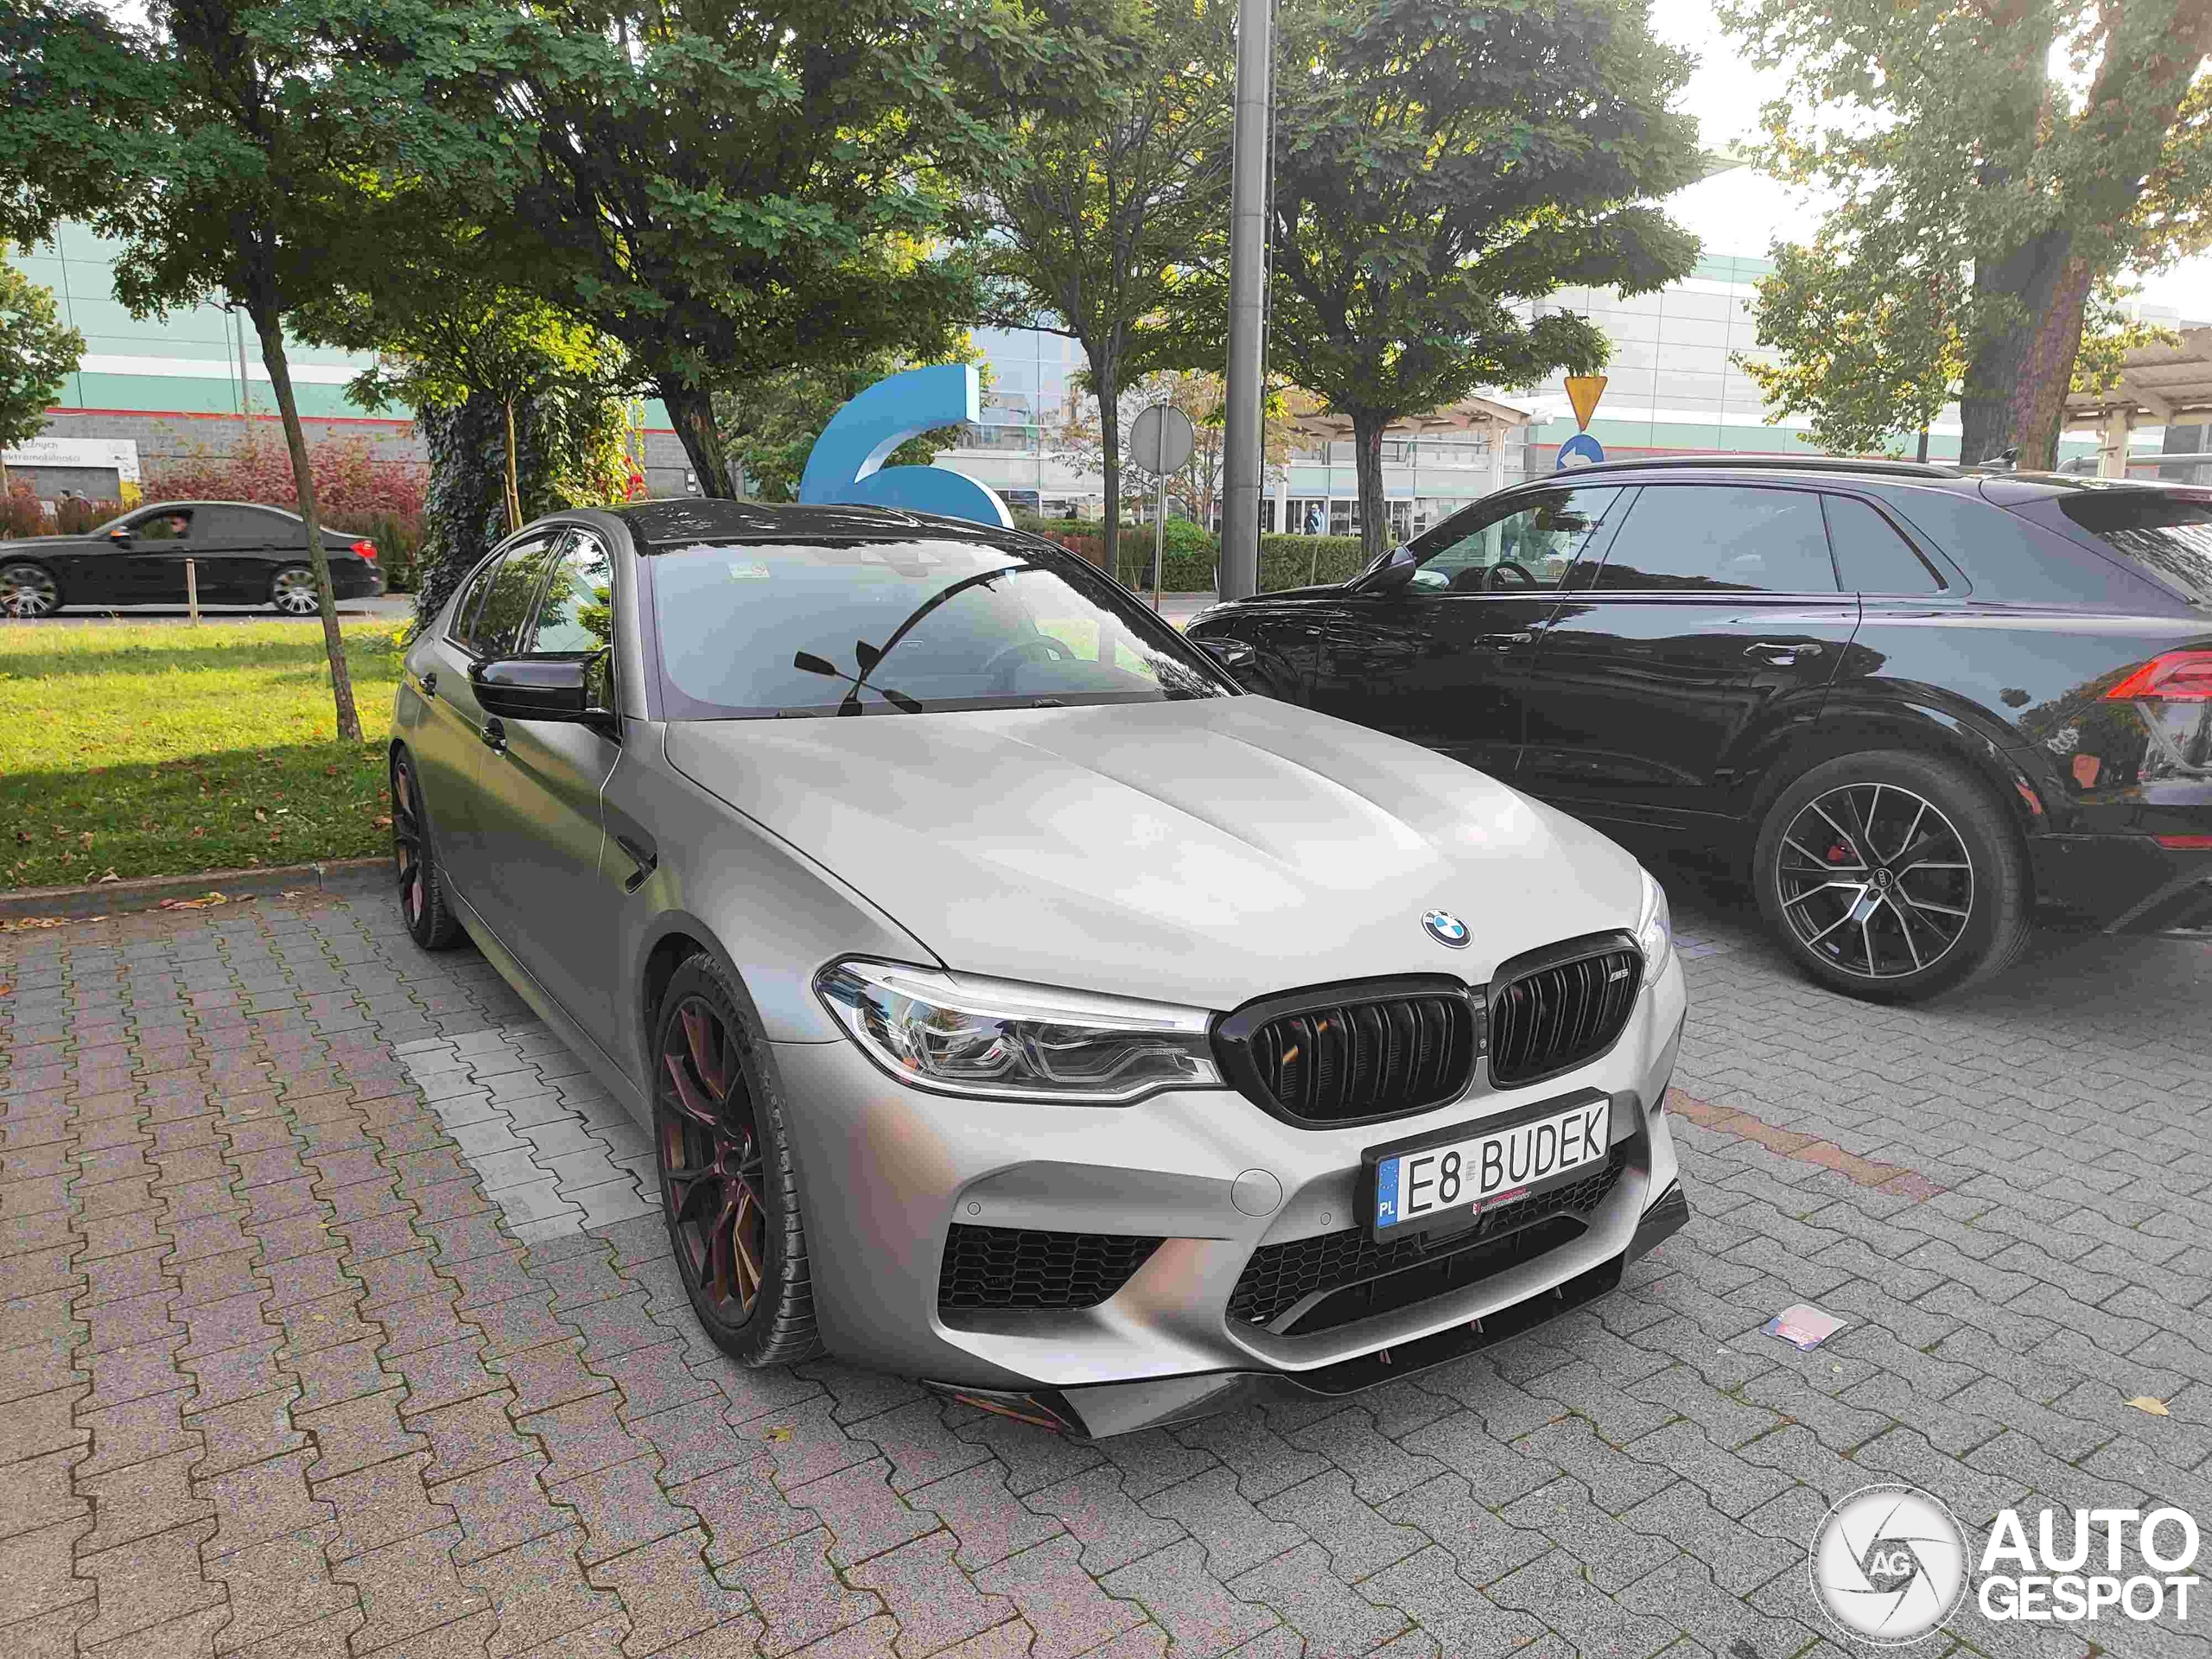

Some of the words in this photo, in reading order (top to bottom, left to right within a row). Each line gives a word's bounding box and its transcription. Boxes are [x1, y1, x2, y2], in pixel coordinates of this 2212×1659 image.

[1408, 1150, 1461, 1214] E8
[1480, 1107, 1605, 1194] BUDEK
[1379, 1200, 1395, 1217] PL
